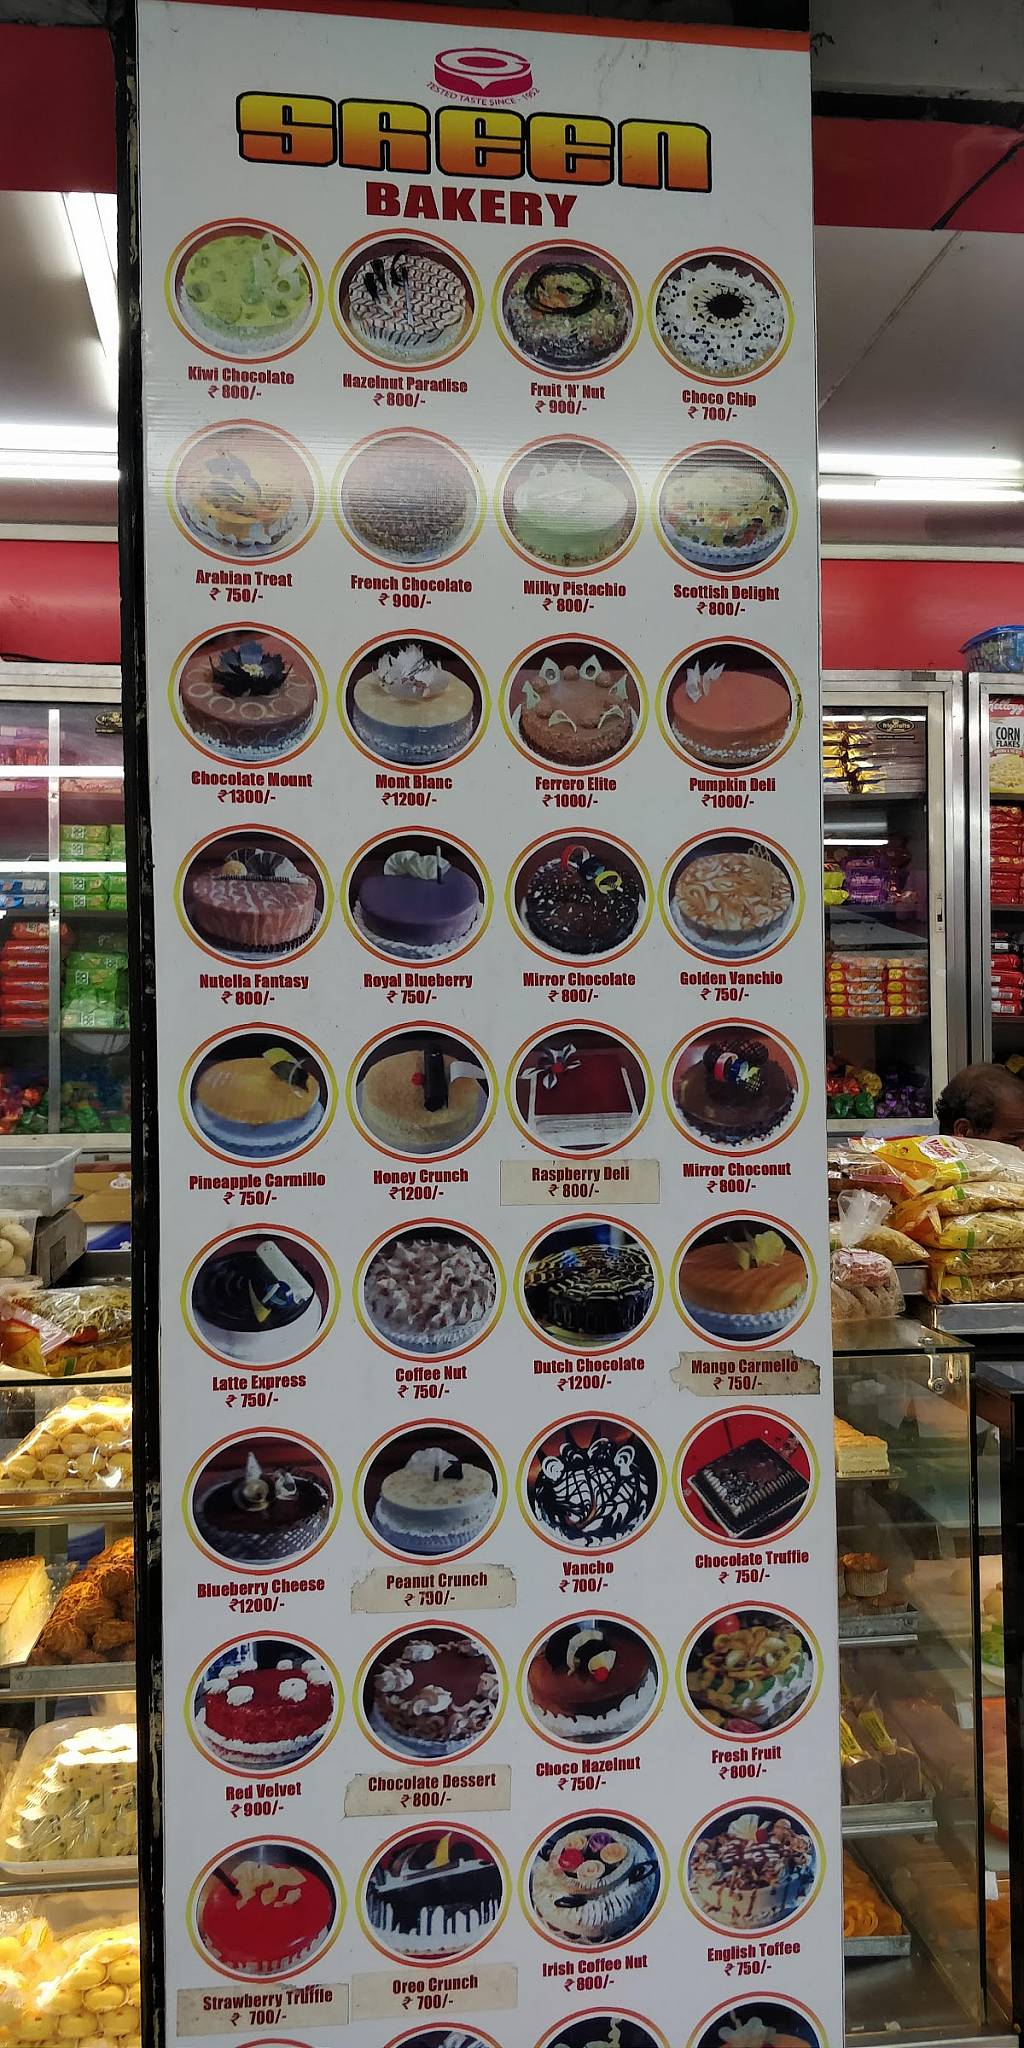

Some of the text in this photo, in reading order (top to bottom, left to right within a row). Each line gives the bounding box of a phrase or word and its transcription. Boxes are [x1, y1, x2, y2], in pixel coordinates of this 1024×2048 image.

[426, 81, 457, 99] TESTED
[459, 94, 487, 106] TASTE
[489, 98, 515, 106] SINCE
[236, 91, 712, 193] SREEN
[366, 181, 578, 228] BAKERY
[188, 366, 294, 384] Kiwi Chocolate
[343, 374, 467, 392] Hazelnut Paradise
[531, 382, 562, 397] Fruit
[583, 385, 605, 399] Nut
[682, 390, 756, 407] Choco Chip
[196, 570, 292, 586] Arabian Treat
[351, 575, 472, 592] French Chocolate
[524, 580, 626, 596] Milky Pistachio
[674, 584, 779, 601] Scottish Delight
[995, 726, 1021, 741] CORN
[192, 771, 312, 787] Chocolate Mount
[376, 774, 452, 789] Mont Blanc
[536, 777, 616, 790] Ferrero Elite
[690, 776, 775, 792] Pumpkin Deli
[200, 974, 308, 989] Nutella Fantasy
[364, 973, 472, 988] Royal Blueberry
[524, 972, 635, 986] Mirror Chocolate
[680, 971, 782, 985] Golden Vanchio
[374, 1168, 468, 1185] Honey Crunch
[532, 1166, 629, 1182] Raspberry Deli
[683, 1163, 791, 1177] Mirror Choconut
[190, 1174, 261, 1190] Pineapple
[396, 1366, 467, 1382] Coffee Nut
[534, 1357, 644, 1374] Dutch Chocolate
[692, 1358, 799, 1375] Mango Carmello
[213, 1375, 306, 1391] Latte Express
[696, 1550, 808, 1568] Chocolate Truffle
[563, 1560, 613, 1576] Vancho
[198, 1579, 324, 1598] Blueberry Cheese
[387, 1572, 487, 1589] Peanut Crunch
[712, 1746, 781, 1763] Fresh Fruit
[536, 1756, 640, 1776] Choco Hazelnut
[226, 1782, 301, 1800] Red Velvet
[369, 1774, 496, 1791] Chocolate Dessert
[708, 1942, 800, 1962] English Toffee
[543, 1955, 647, 1977] Irish Coffee Nut
[393, 1975, 478, 1994] Oreo Crunch
[204, 1988, 332, 2010] Strawberry Truffle
